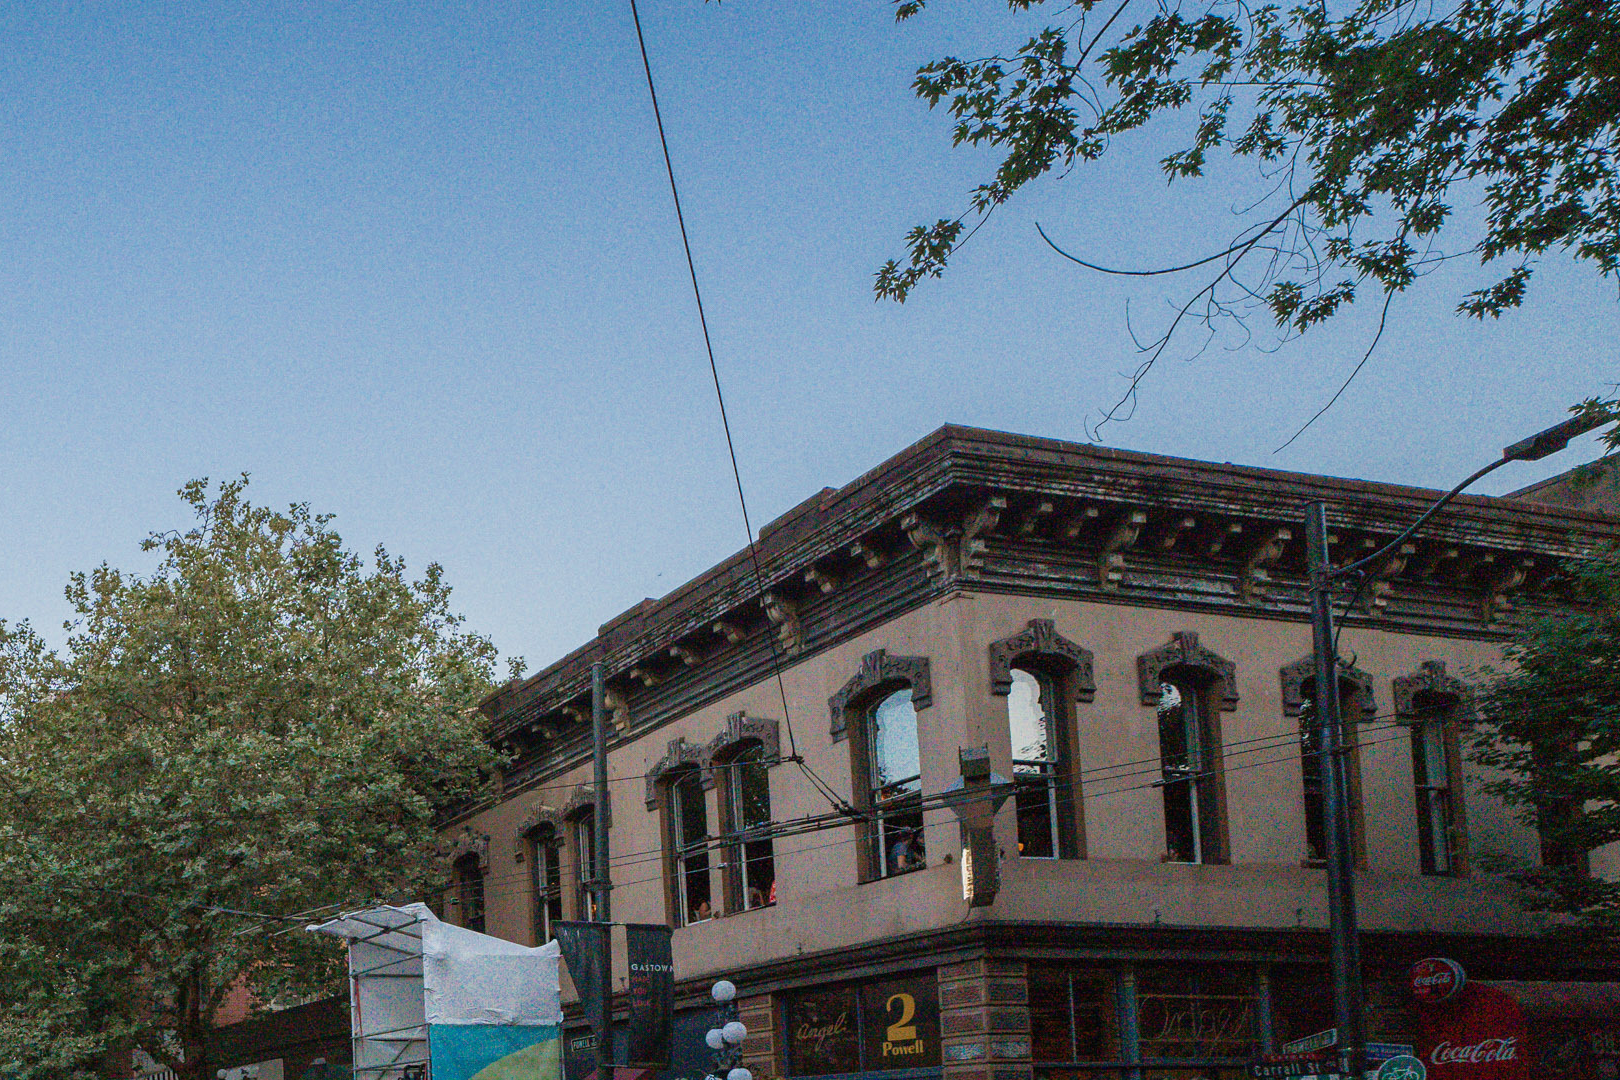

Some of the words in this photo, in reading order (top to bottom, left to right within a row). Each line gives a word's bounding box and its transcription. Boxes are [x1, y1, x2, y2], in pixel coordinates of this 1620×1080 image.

[630, 963, 674, 972] GASTOWN
[886, 992, 917, 1041] 2
[882, 1039, 924, 1056] Powell
[1253, 1062, 1301, 1077] Carrall
